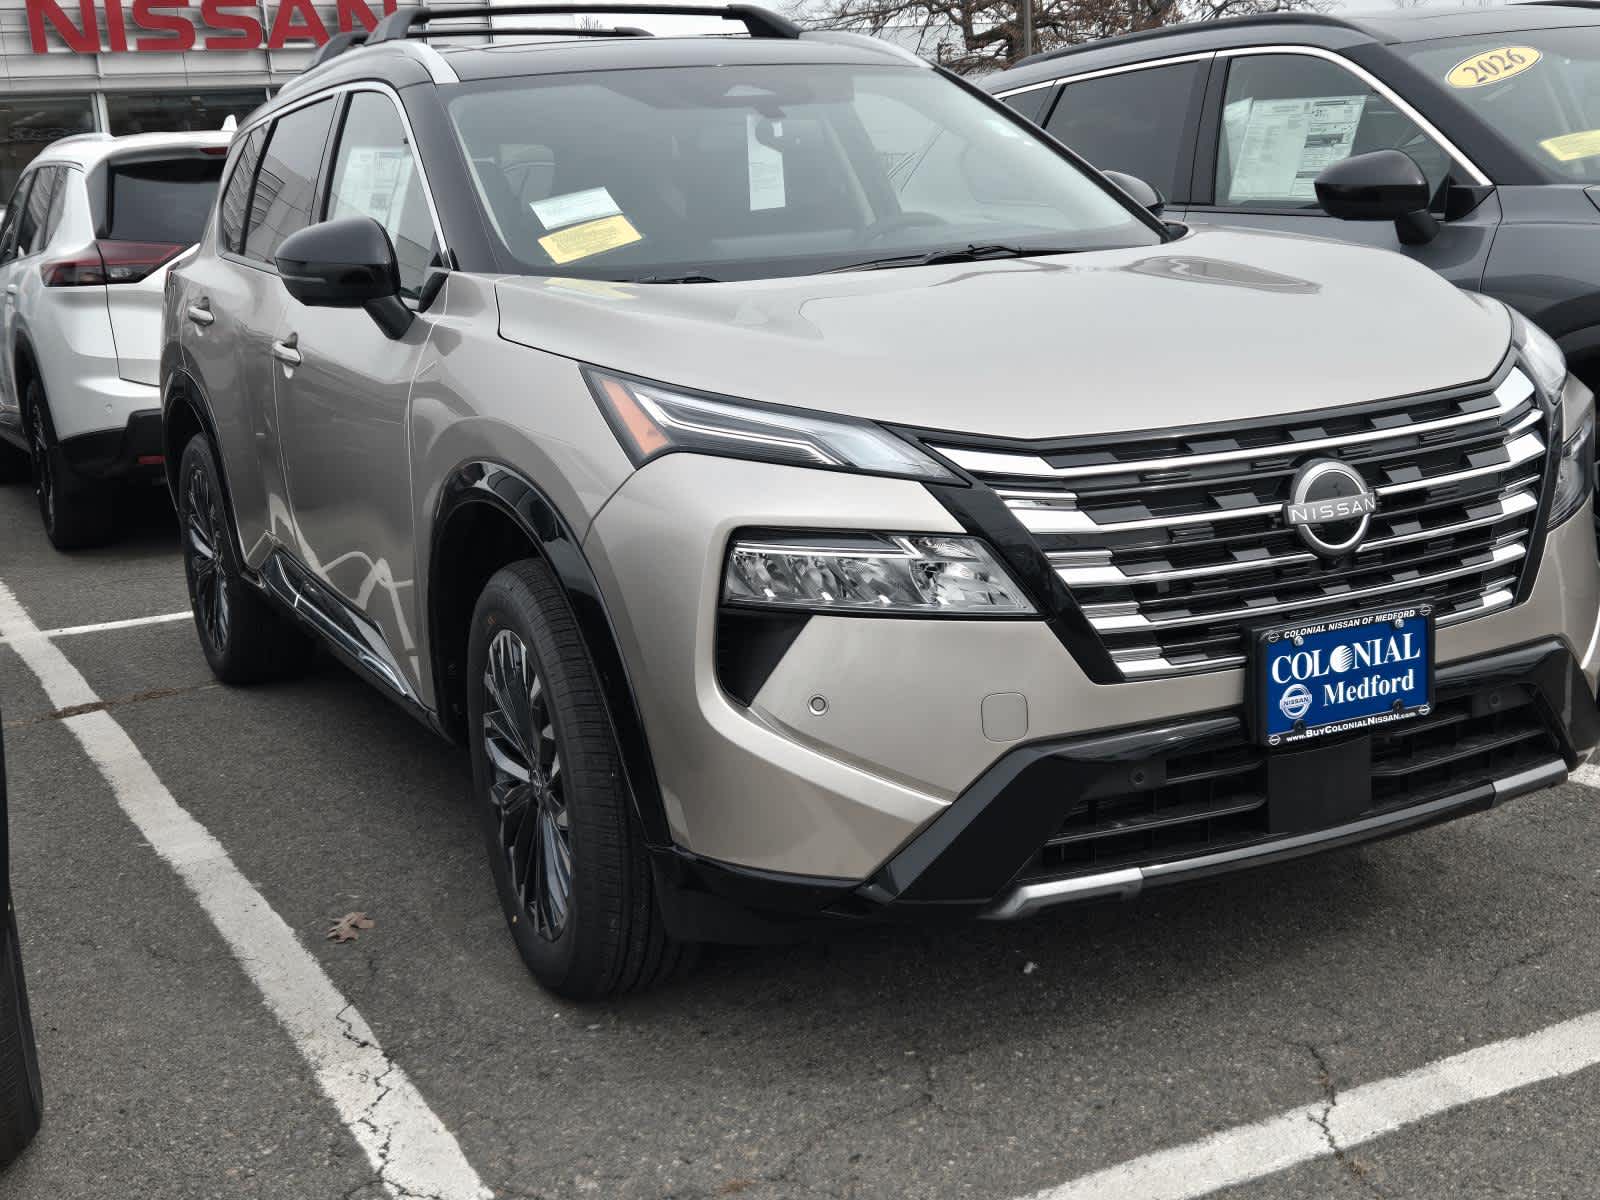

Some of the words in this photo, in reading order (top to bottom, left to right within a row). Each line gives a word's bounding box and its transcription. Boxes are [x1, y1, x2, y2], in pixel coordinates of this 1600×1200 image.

[1463, 49, 1526, 83] 2026
[1291, 495, 1375, 521] NISSAN
[1284, 625, 1326, 639] COLONIAL
[1328, 618, 1360, 631] NISSAN
[1362, 616, 1373, 625] OF
[1375, 609, 1415, 623] MEDFORD
[1271, 632, 1421, 684] COLONIAL
[1283, 696, 1310, 706] NISSAN
[1323, 668, 1415, 707] Medford
